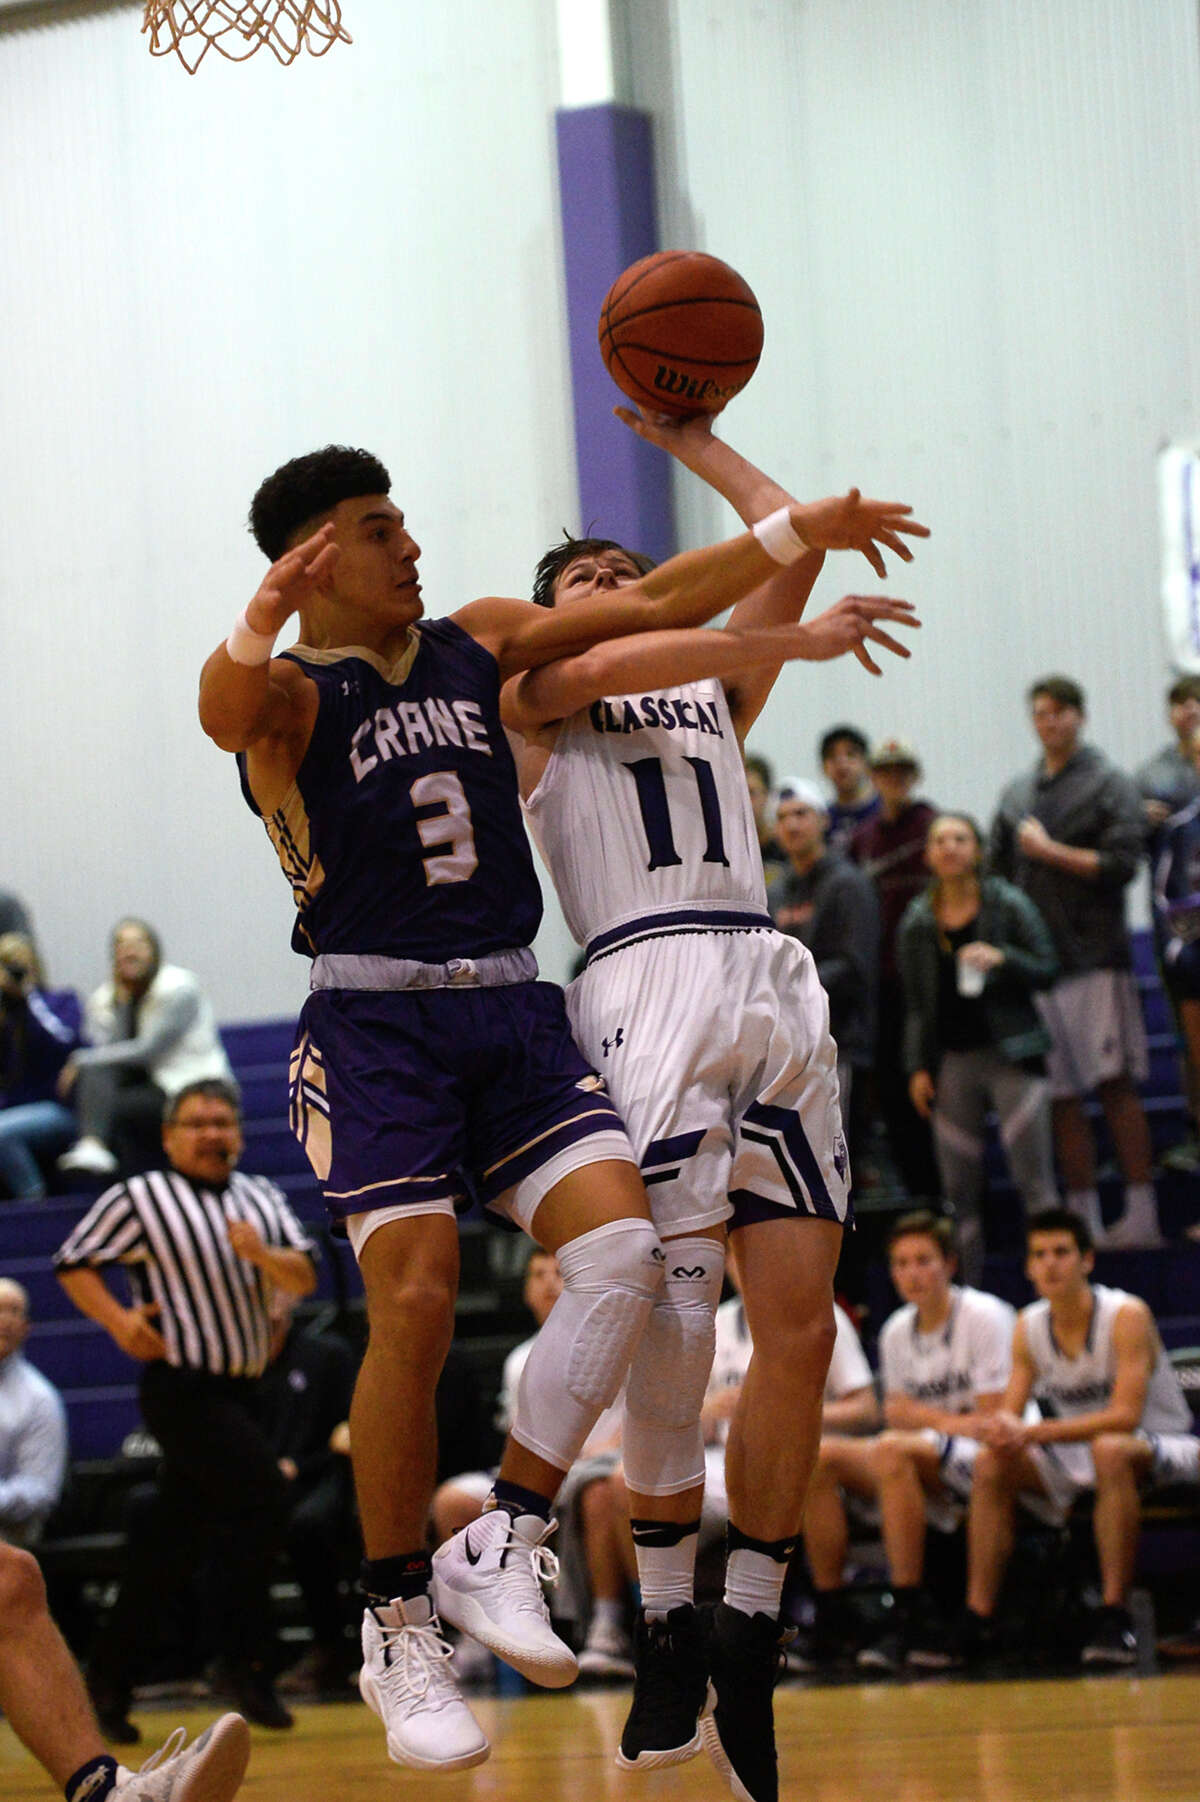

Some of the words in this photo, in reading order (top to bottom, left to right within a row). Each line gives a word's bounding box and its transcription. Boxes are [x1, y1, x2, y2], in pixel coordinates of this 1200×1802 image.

[349, 697, 494, 785] CRANE
[409, 770, 479, 887] 3
[620, 755, 731, 872] 11
